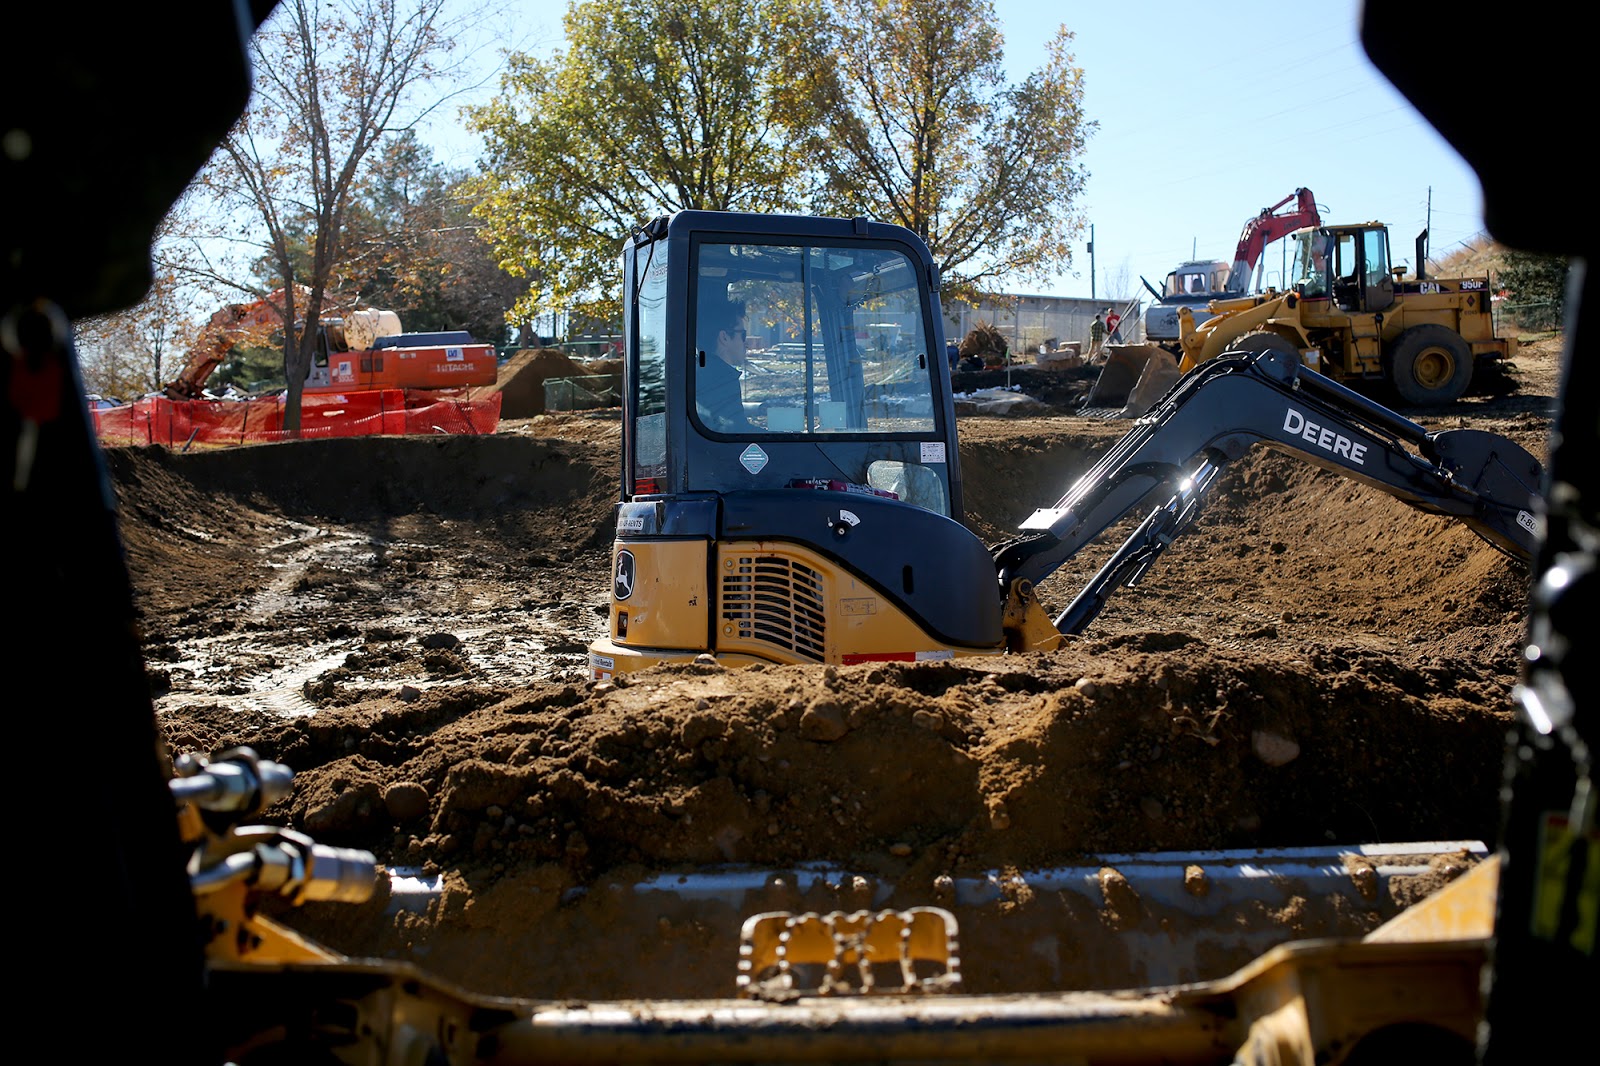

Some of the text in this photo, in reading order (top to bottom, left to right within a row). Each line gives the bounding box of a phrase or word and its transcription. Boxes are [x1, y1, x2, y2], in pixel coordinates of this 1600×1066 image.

[1420, 282, 1440, 295] CAT
[436, 363, 475, 373] HITACHI
[1283, 408, 1368, 466] DEERE
